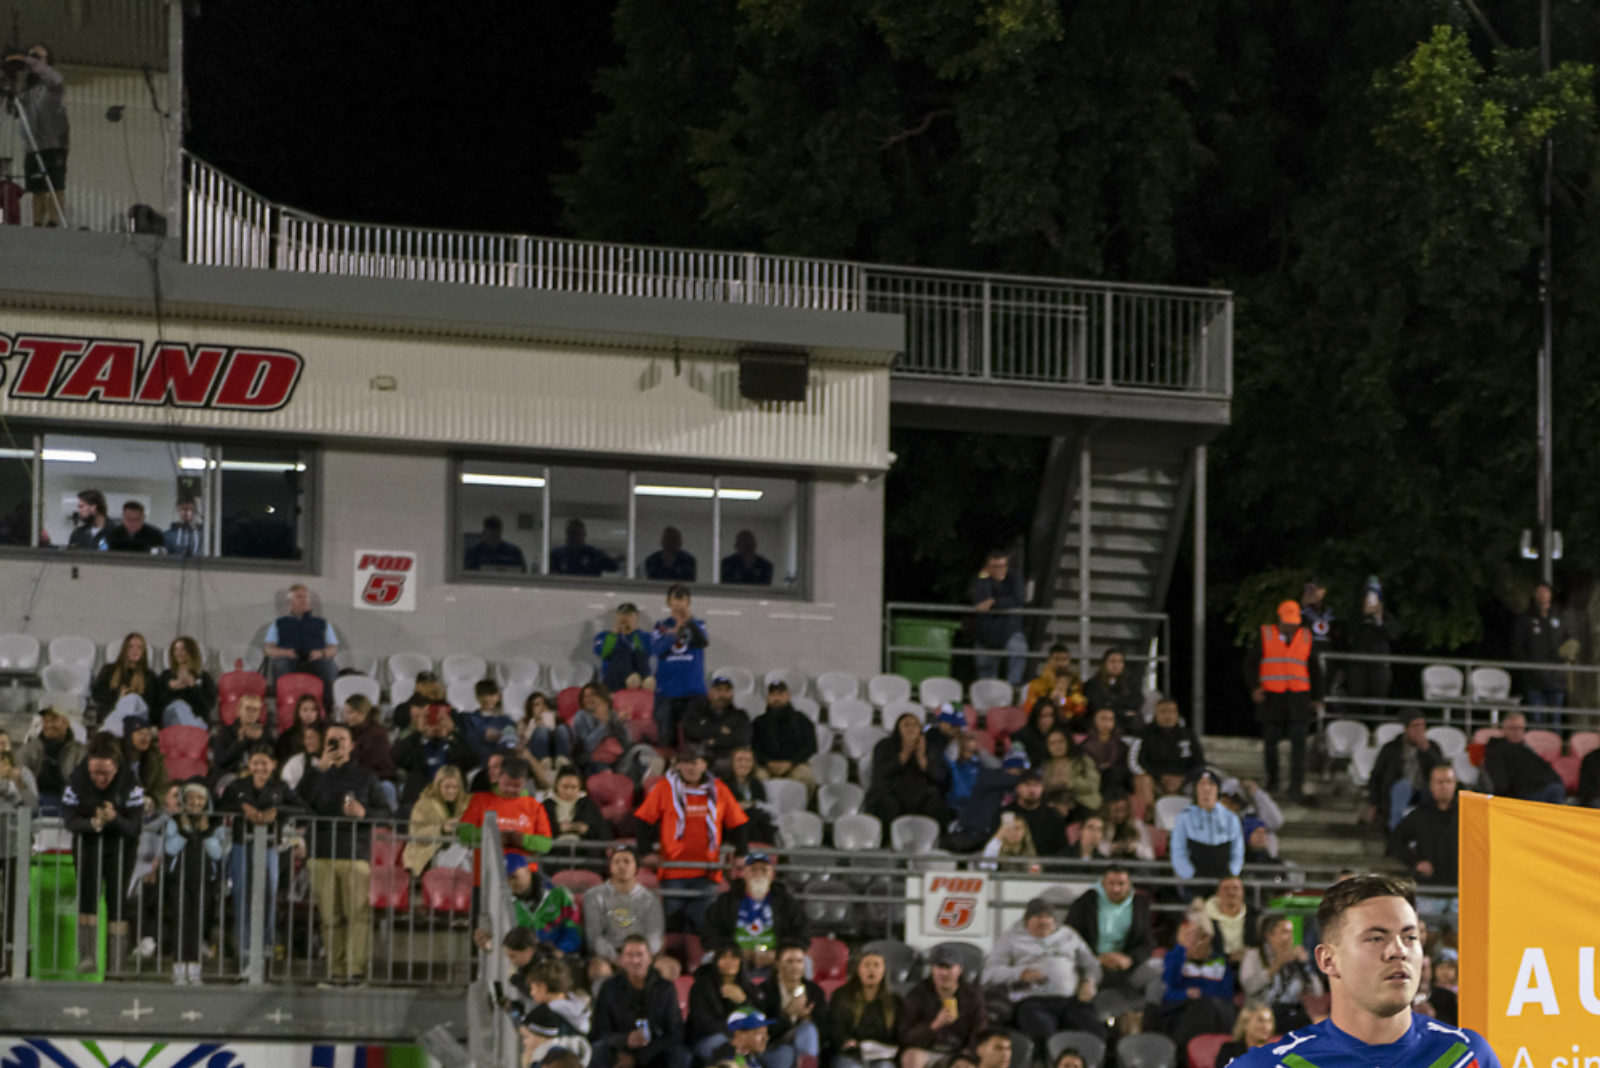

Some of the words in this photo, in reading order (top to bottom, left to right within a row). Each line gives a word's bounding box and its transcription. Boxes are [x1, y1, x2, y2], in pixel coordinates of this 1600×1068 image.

[0, 332, 304, 411] TAND
[362, 573, 407, 606] 5
[930, 876, 984, 893] POD
[934, 897, 977, 931] 5
